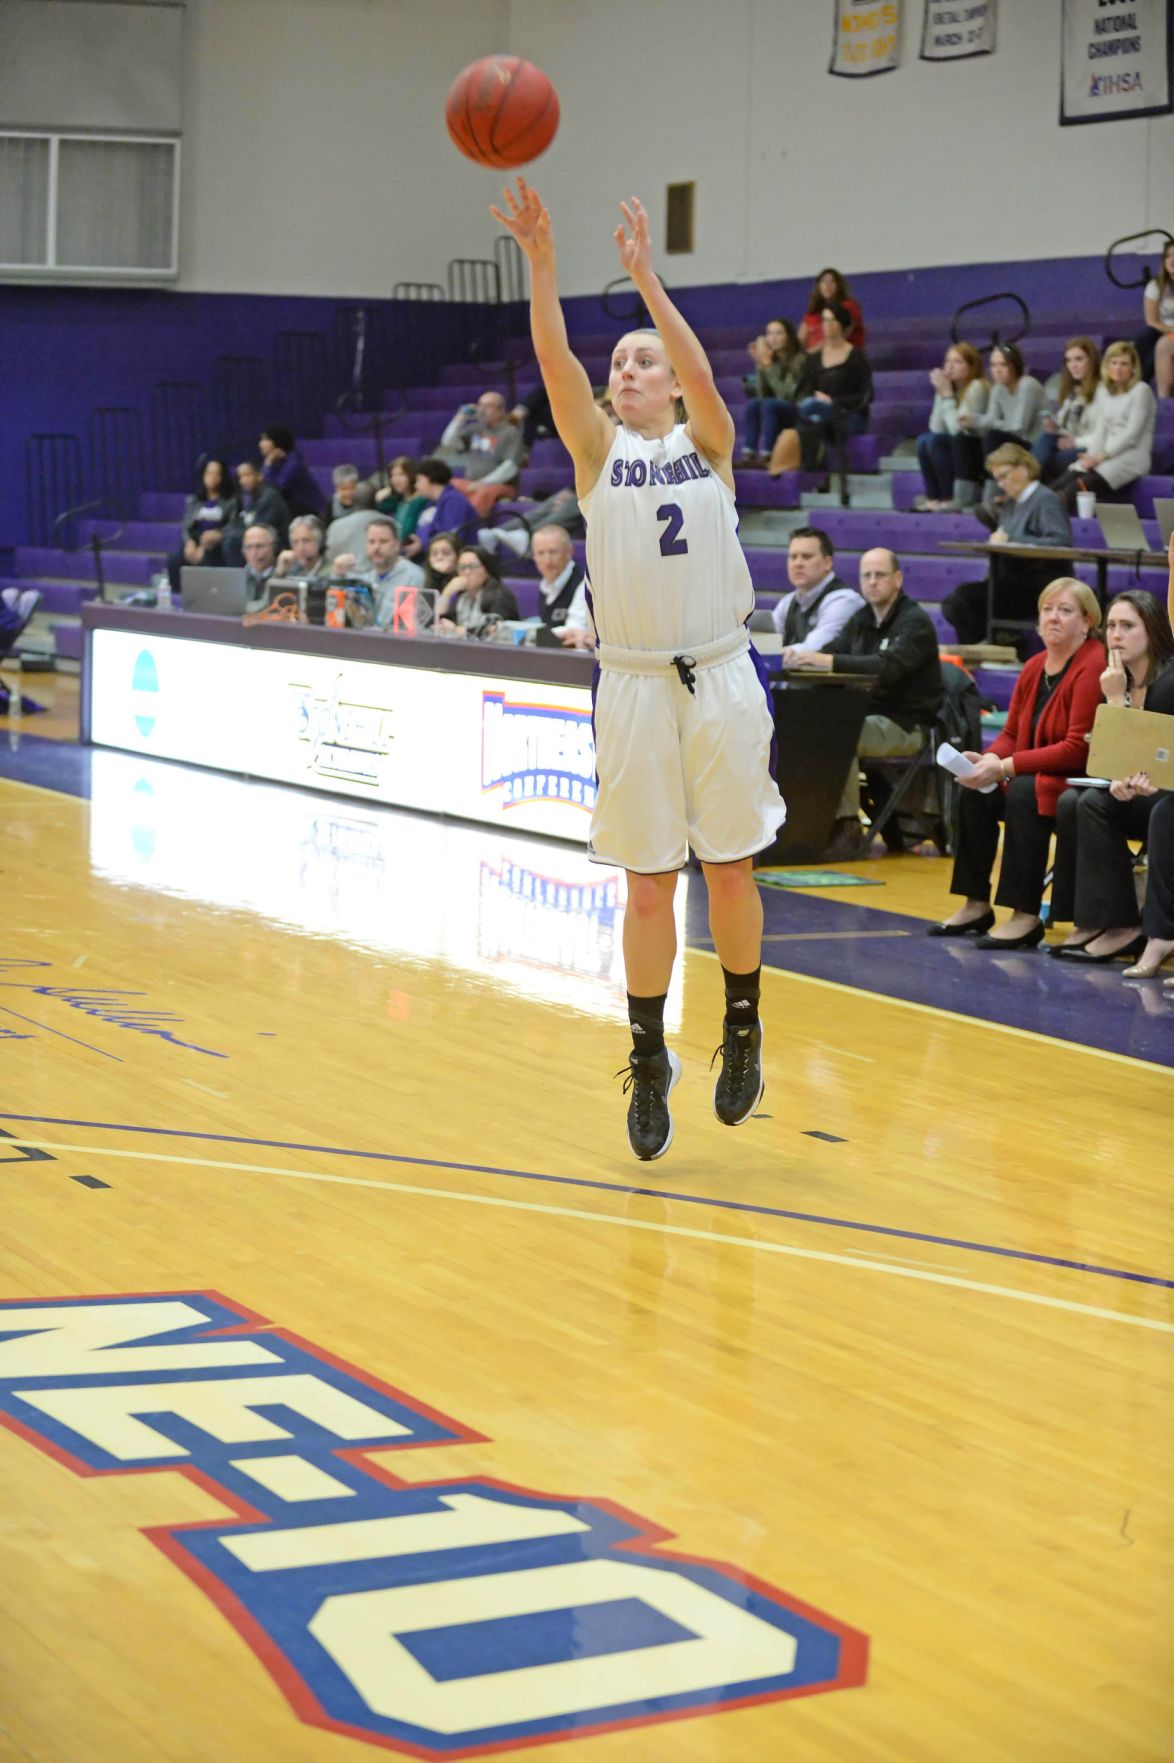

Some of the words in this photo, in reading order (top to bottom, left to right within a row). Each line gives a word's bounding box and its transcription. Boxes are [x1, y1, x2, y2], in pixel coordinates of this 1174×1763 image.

[1094, 13, 1137, 35] NATIONAL
[1088, 36, 1141, 60] CHAMPIONS
[611, 452, 712, 488] STONEHIL
[656, 503, 689, 557] 2
